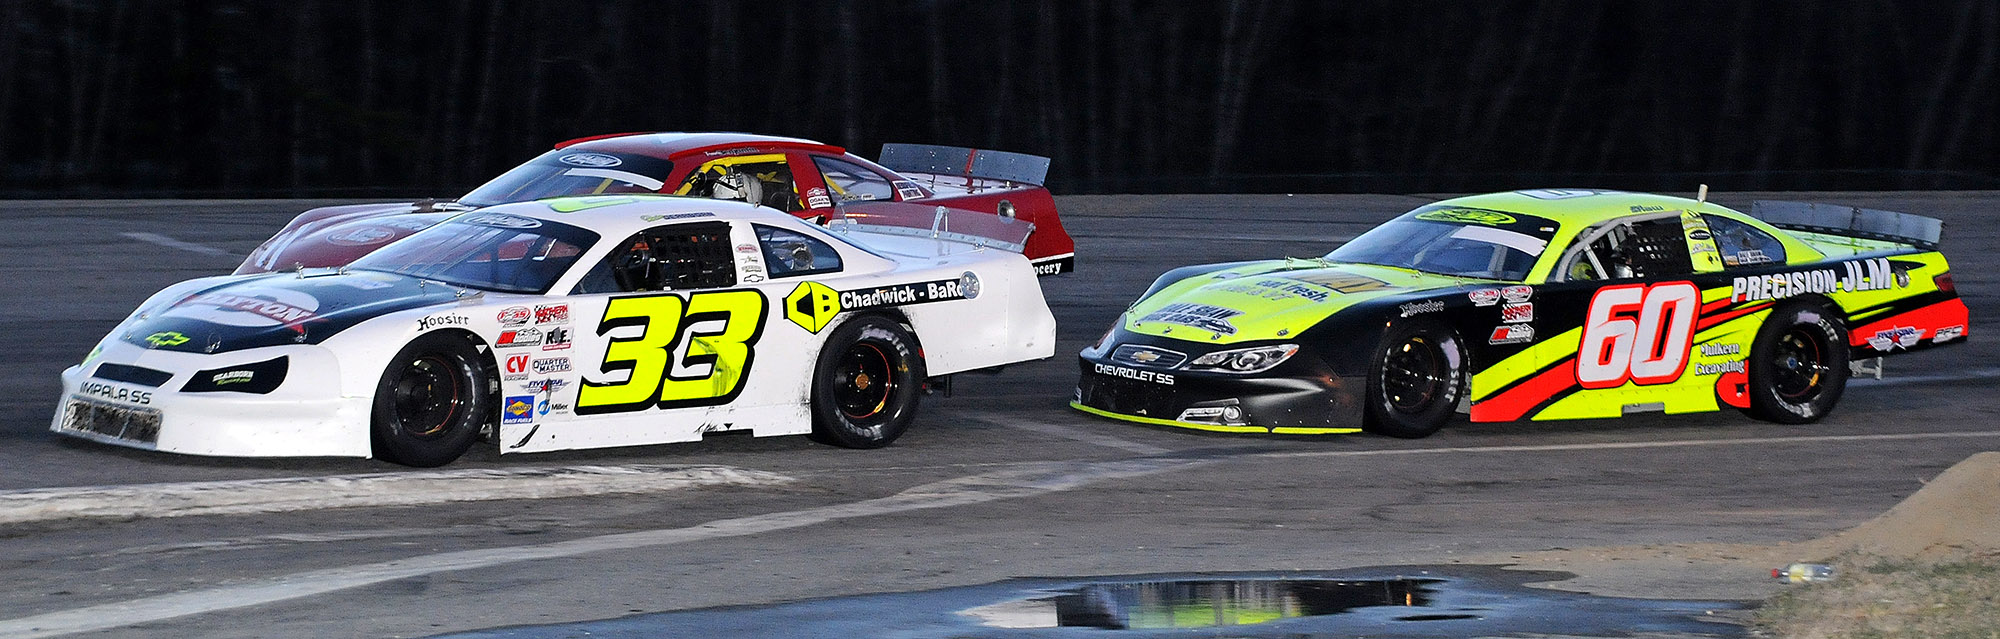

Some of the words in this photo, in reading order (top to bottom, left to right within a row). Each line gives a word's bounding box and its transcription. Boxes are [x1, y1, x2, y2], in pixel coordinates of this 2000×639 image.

[1731, 269, 1837, 303] PRECISION
[1842, 257, 1892, 292] JLM
[841, 288, 917, 309] Chadwick
[417, 312, 470, 331] Hoosier
[1576, 281, 1700, 388] 60
[575, 289, 768, 414] 33
[1701, 342, 1740, 357] Mulkern
[506, 355, 529, 373] CV
[533, 358, 568, 369] QUARTER
[540, 364, 569, 372] MASTER
[1694, 359, 1745, 376] Excavating
[1094, 363, 1156, 382] CHEVROLET
[1156, 373, 1175, 385] SS
[79, 381, 128, 401] IMPALA
[131, 390, 153, 404] SS
